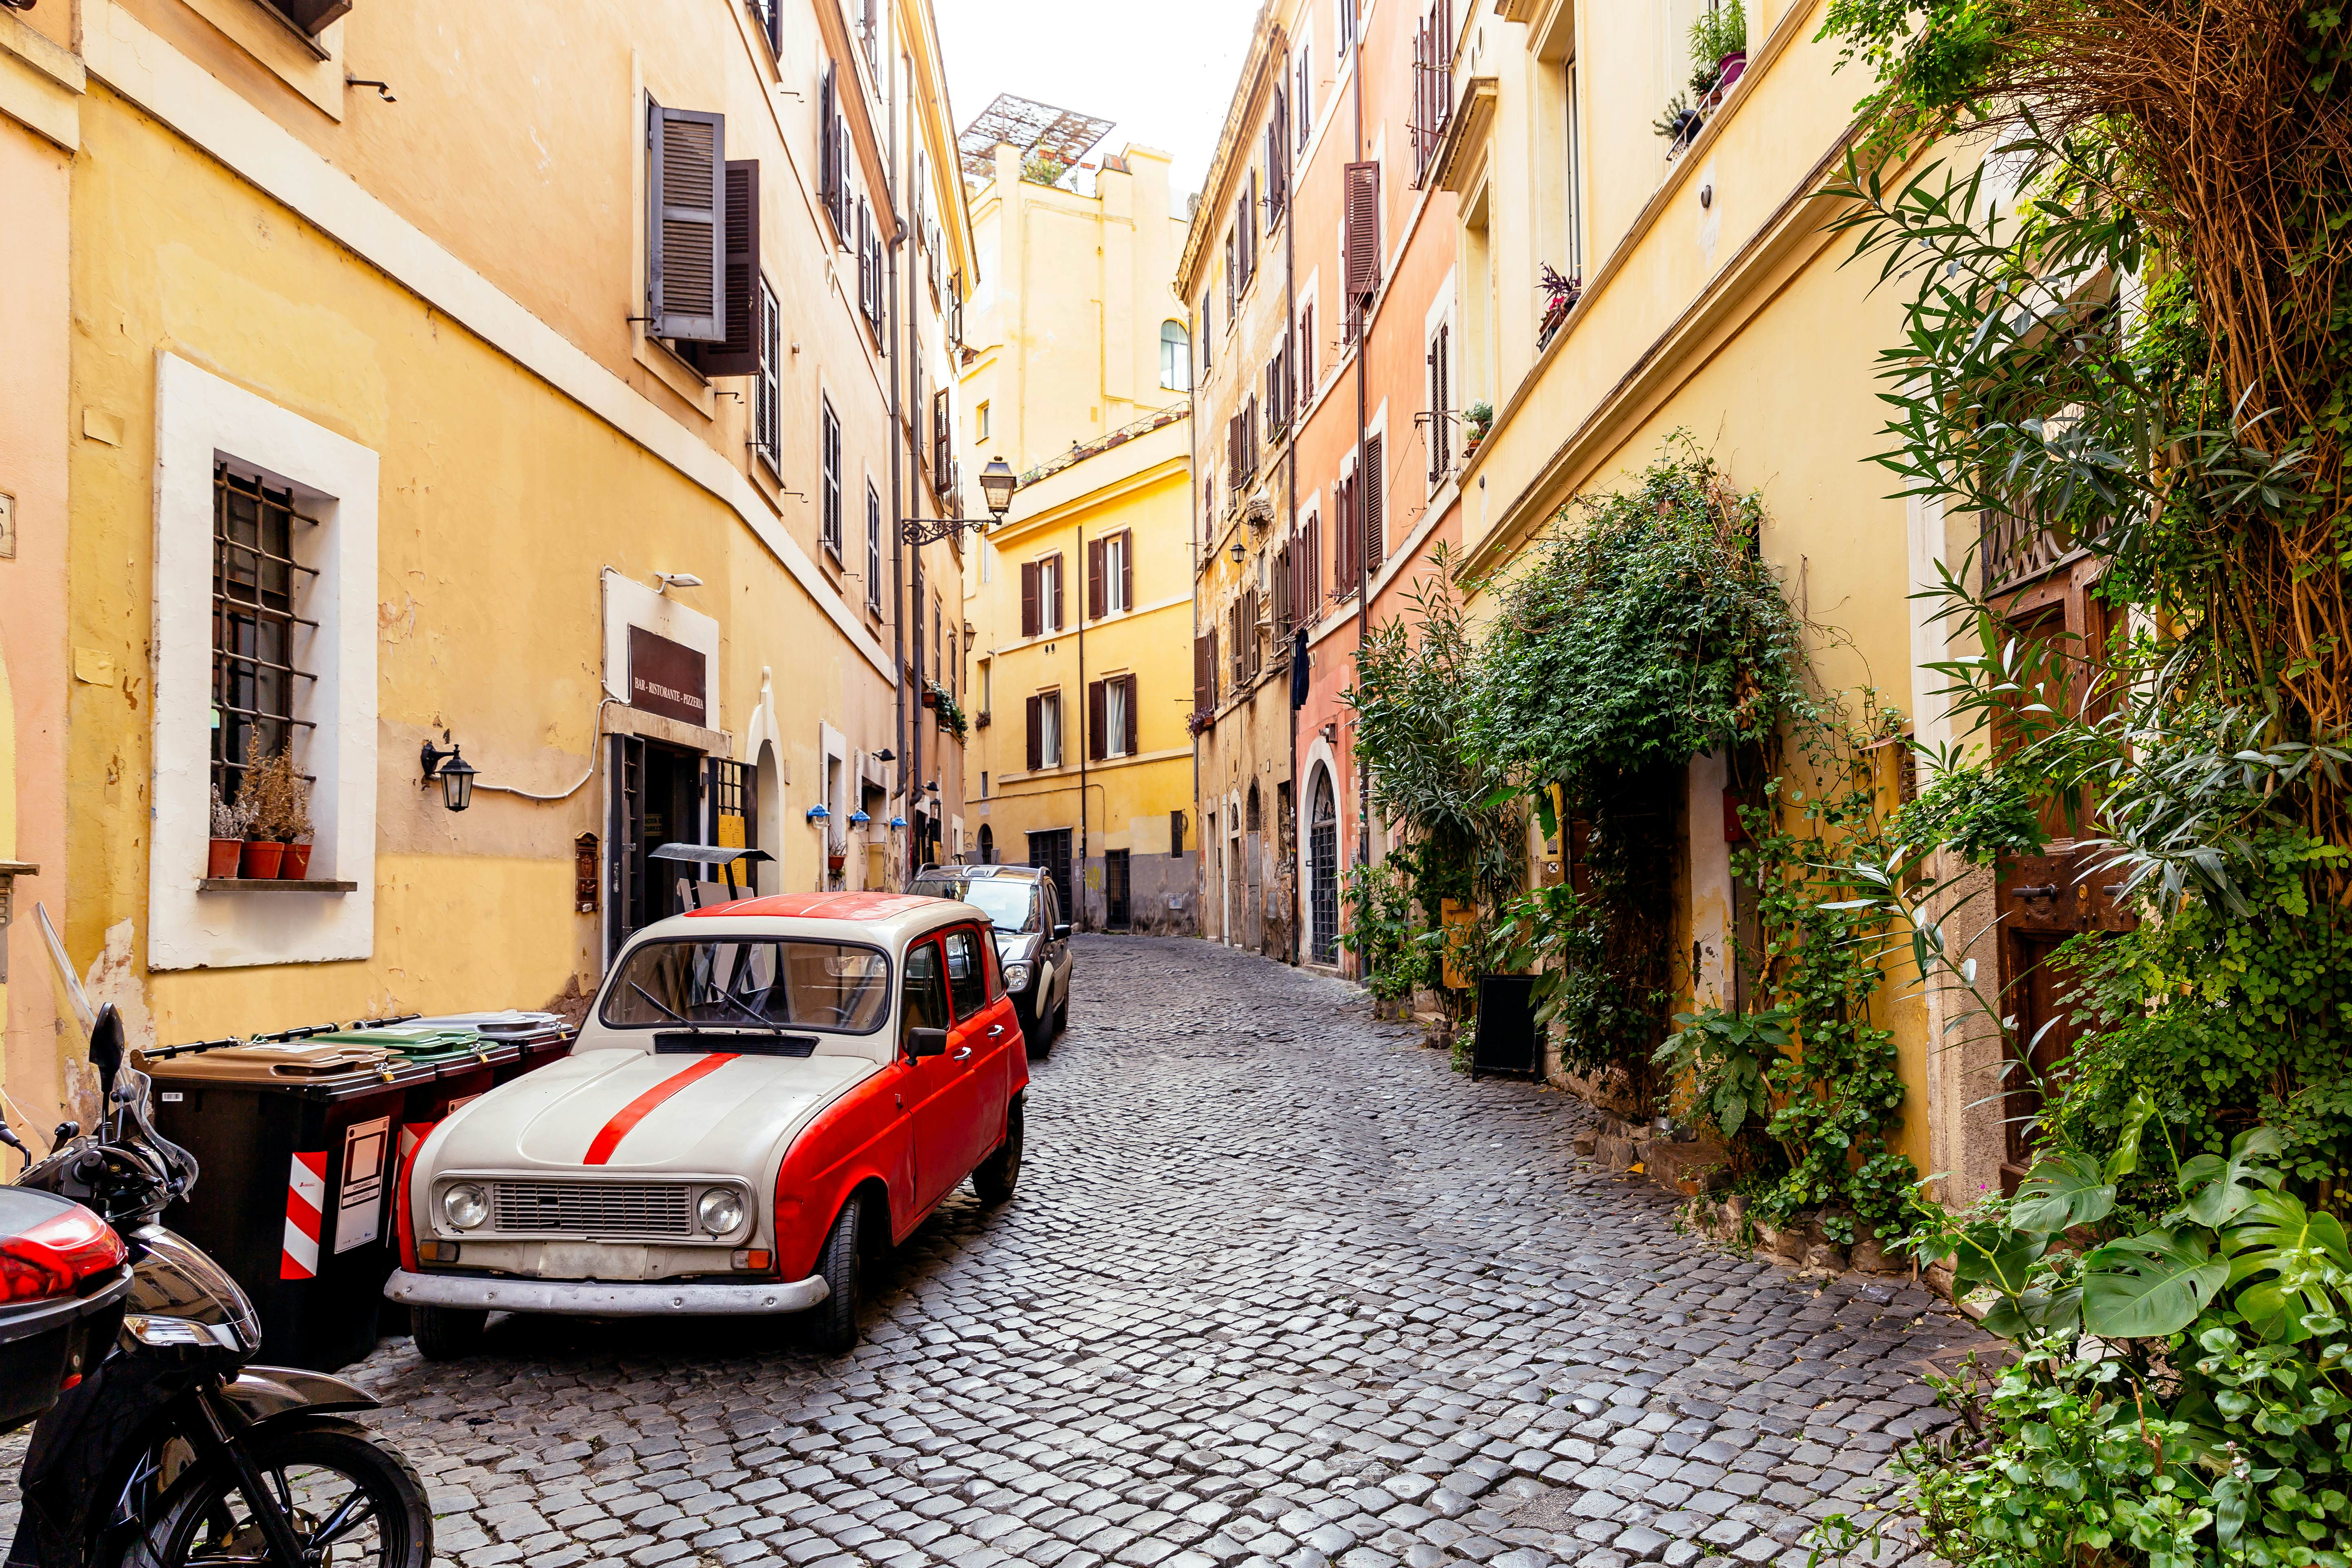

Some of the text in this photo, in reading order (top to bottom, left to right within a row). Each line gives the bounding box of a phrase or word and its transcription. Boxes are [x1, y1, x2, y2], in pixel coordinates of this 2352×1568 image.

[635, 677, 645, 691] BAR
[649, 682, 680, 702] RISTORANTE
[683, 693, 704, 709] PIZZERIA
